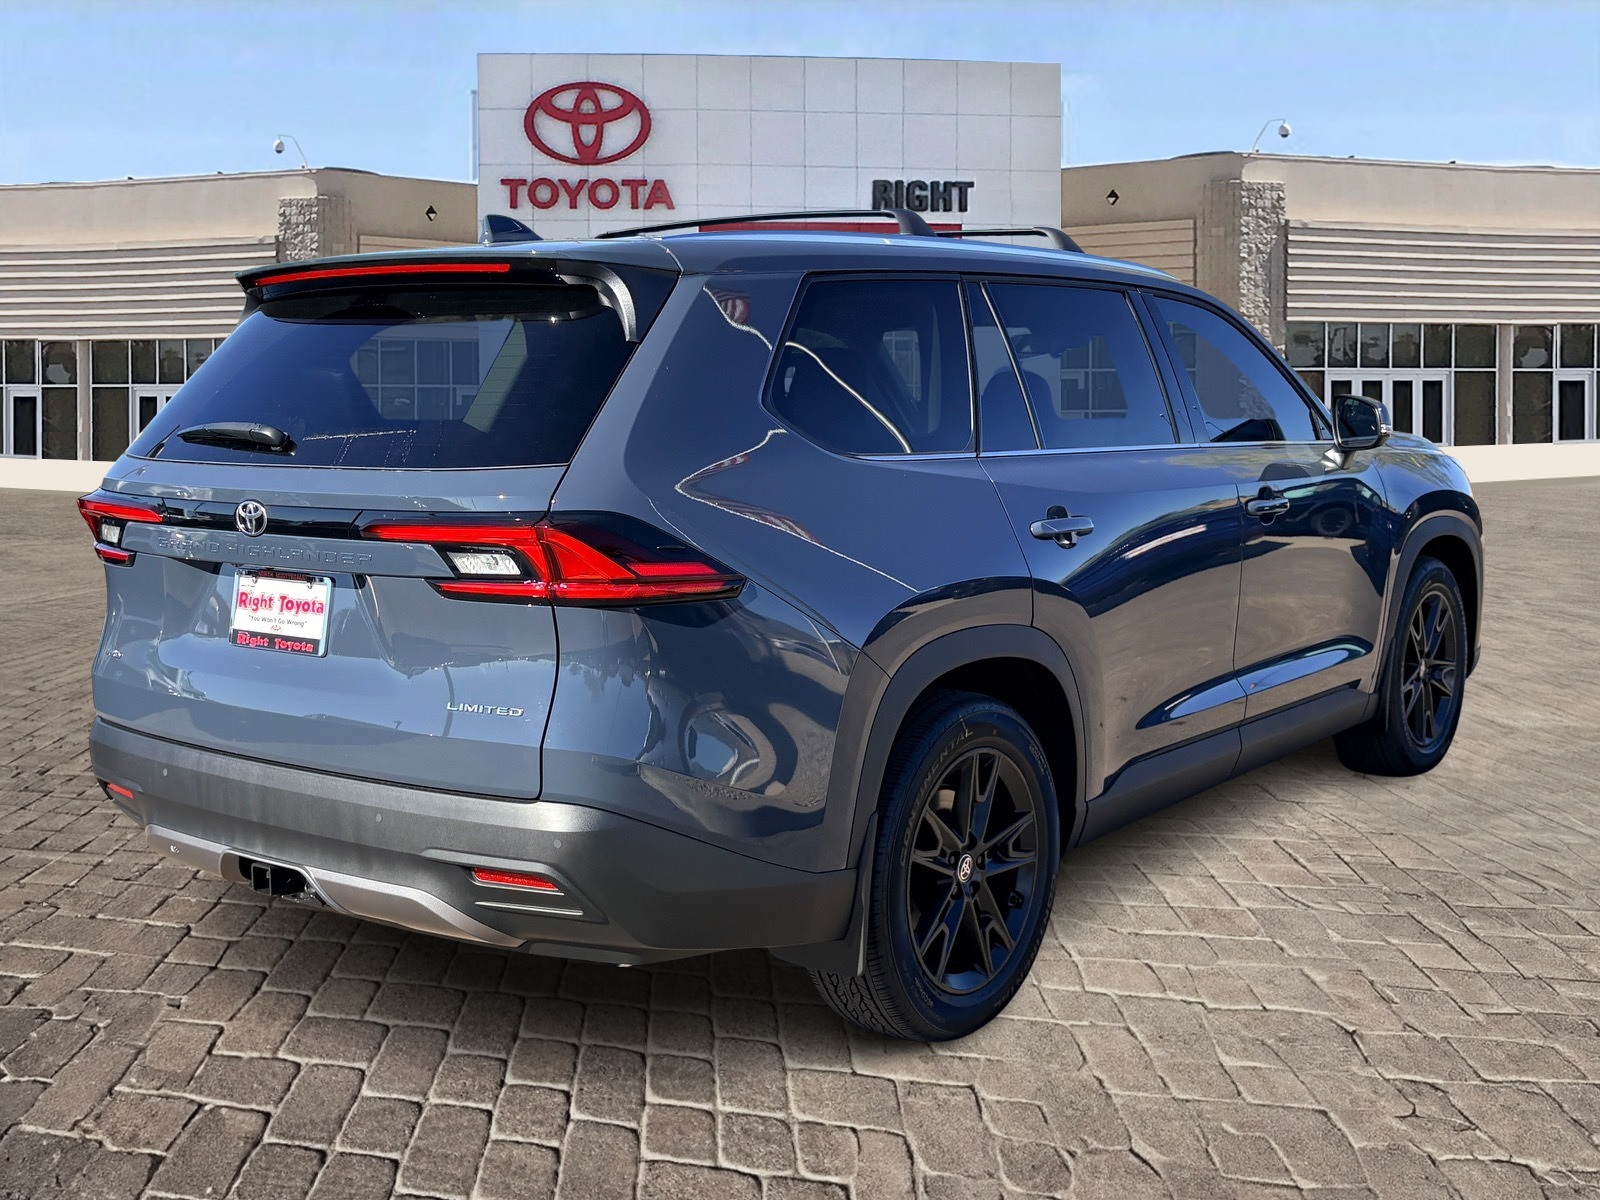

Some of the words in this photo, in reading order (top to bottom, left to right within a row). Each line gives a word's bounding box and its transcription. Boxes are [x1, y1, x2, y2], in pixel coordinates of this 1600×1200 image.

[500, 177, 675, 210] TOYOTA
[872, 179, 975, 212] RIGHT
[158, 536, 220, 553] GRAND
[227, 542, 373, 565] HIGHLANDER
[238, 591, 274, 612] Right
[279, 595, 325, 614] Toyota
[236, 633, 269, 648] Right
[274, 638, 314, 652] Toyota
[446, 702, 524, 716] LIMITED
